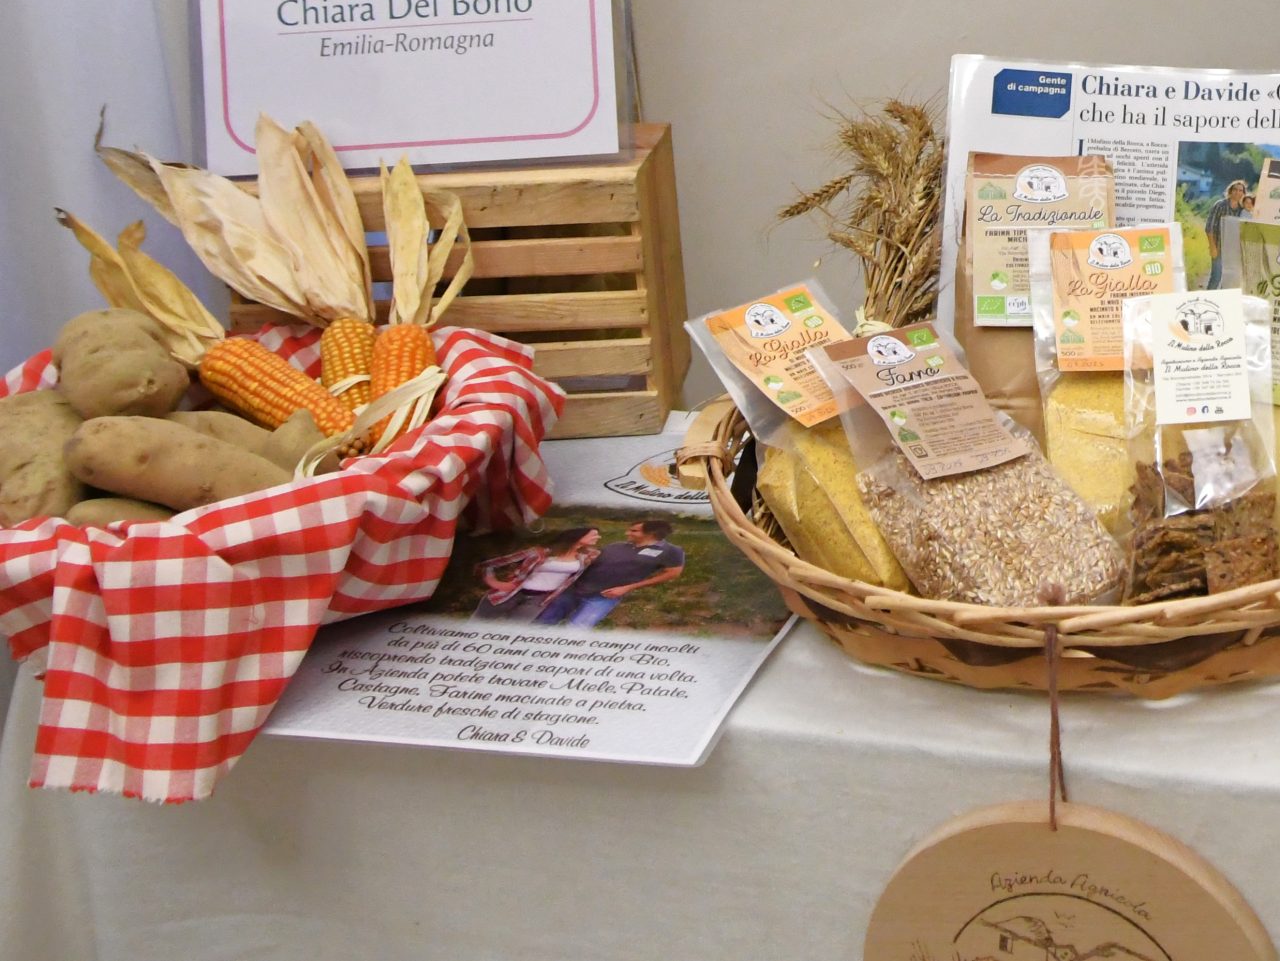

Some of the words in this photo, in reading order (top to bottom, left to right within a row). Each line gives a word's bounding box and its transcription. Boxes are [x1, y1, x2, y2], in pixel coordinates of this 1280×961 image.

[319, 32, 495, 58] Emilia-Romagna
[1007, 83, 1017, 91] di
[1018, 84, 1066, 95] campagna
[1038, 75, 1067, 85] Gente
[1081, 74, 1157, 99] Chiara
[1164, 87, 1176, 99] e
[1183, 80, 1260, 102] Davide
[1079, 102, 1115, 124] che
[1121, 104, 1146, 125] ha
[1154, 106, 1166, 126] il
[1172, 113, 1240, 133] sapore
[977, 205, 1002, 223] La
[1006, 203, 1104, 225] Tradizionale
[1067, 279, 1094, 297] La
[1088, 272, 1158, 299] Gialla
[876, 366, 940, 387] Farro
[631, 483, 672, 499] Mulino
[674, 491, 710, 501] della
[387, 636, 408, 648] da
[409, 639, 438, 651] più
[441, 641, 460, 651] di
[462, 643, 492, 654] 60
[493, 646, 529, 657] anni
[531, 649, 561, 659] con
[563, 651, 625, 664] metodo
[388, 623, 479, 640] Coltiviamo
[482, 632, 510, 641] con
[510, 633, 586, 648] passione
[589, 640, 642, 653] campi
[644, 642, 700, 655] incolti
[338, 649, 436, 669] riscoprendo
[439, 655, 522, 671] tradizioni
[522, 664, 534, 672] e
[535, 663, 594, 677] sapori
[594, 665, 614, 678] di
[615, 671, 646, 680] una
[350, 664, 429, 680] Azienda
[428, 669, 485, 684] potete
[487, 674, 548, 689] trovare
[358, 695, 433, 714] Verdure
[433, 701, 499, 720] fresche
[501, 707, 518, 720] di
[429, 684, 493, 702] Farine
[495, 692, 572, 708] macinate
[575, 698, 588, 708] a
[457, 724, 509, 742] Chiara
[530, 729, 591, 749] Davide
[990, 870, 1067, 894] Azienda
[1070, 873, 1153, 922] Agricola
